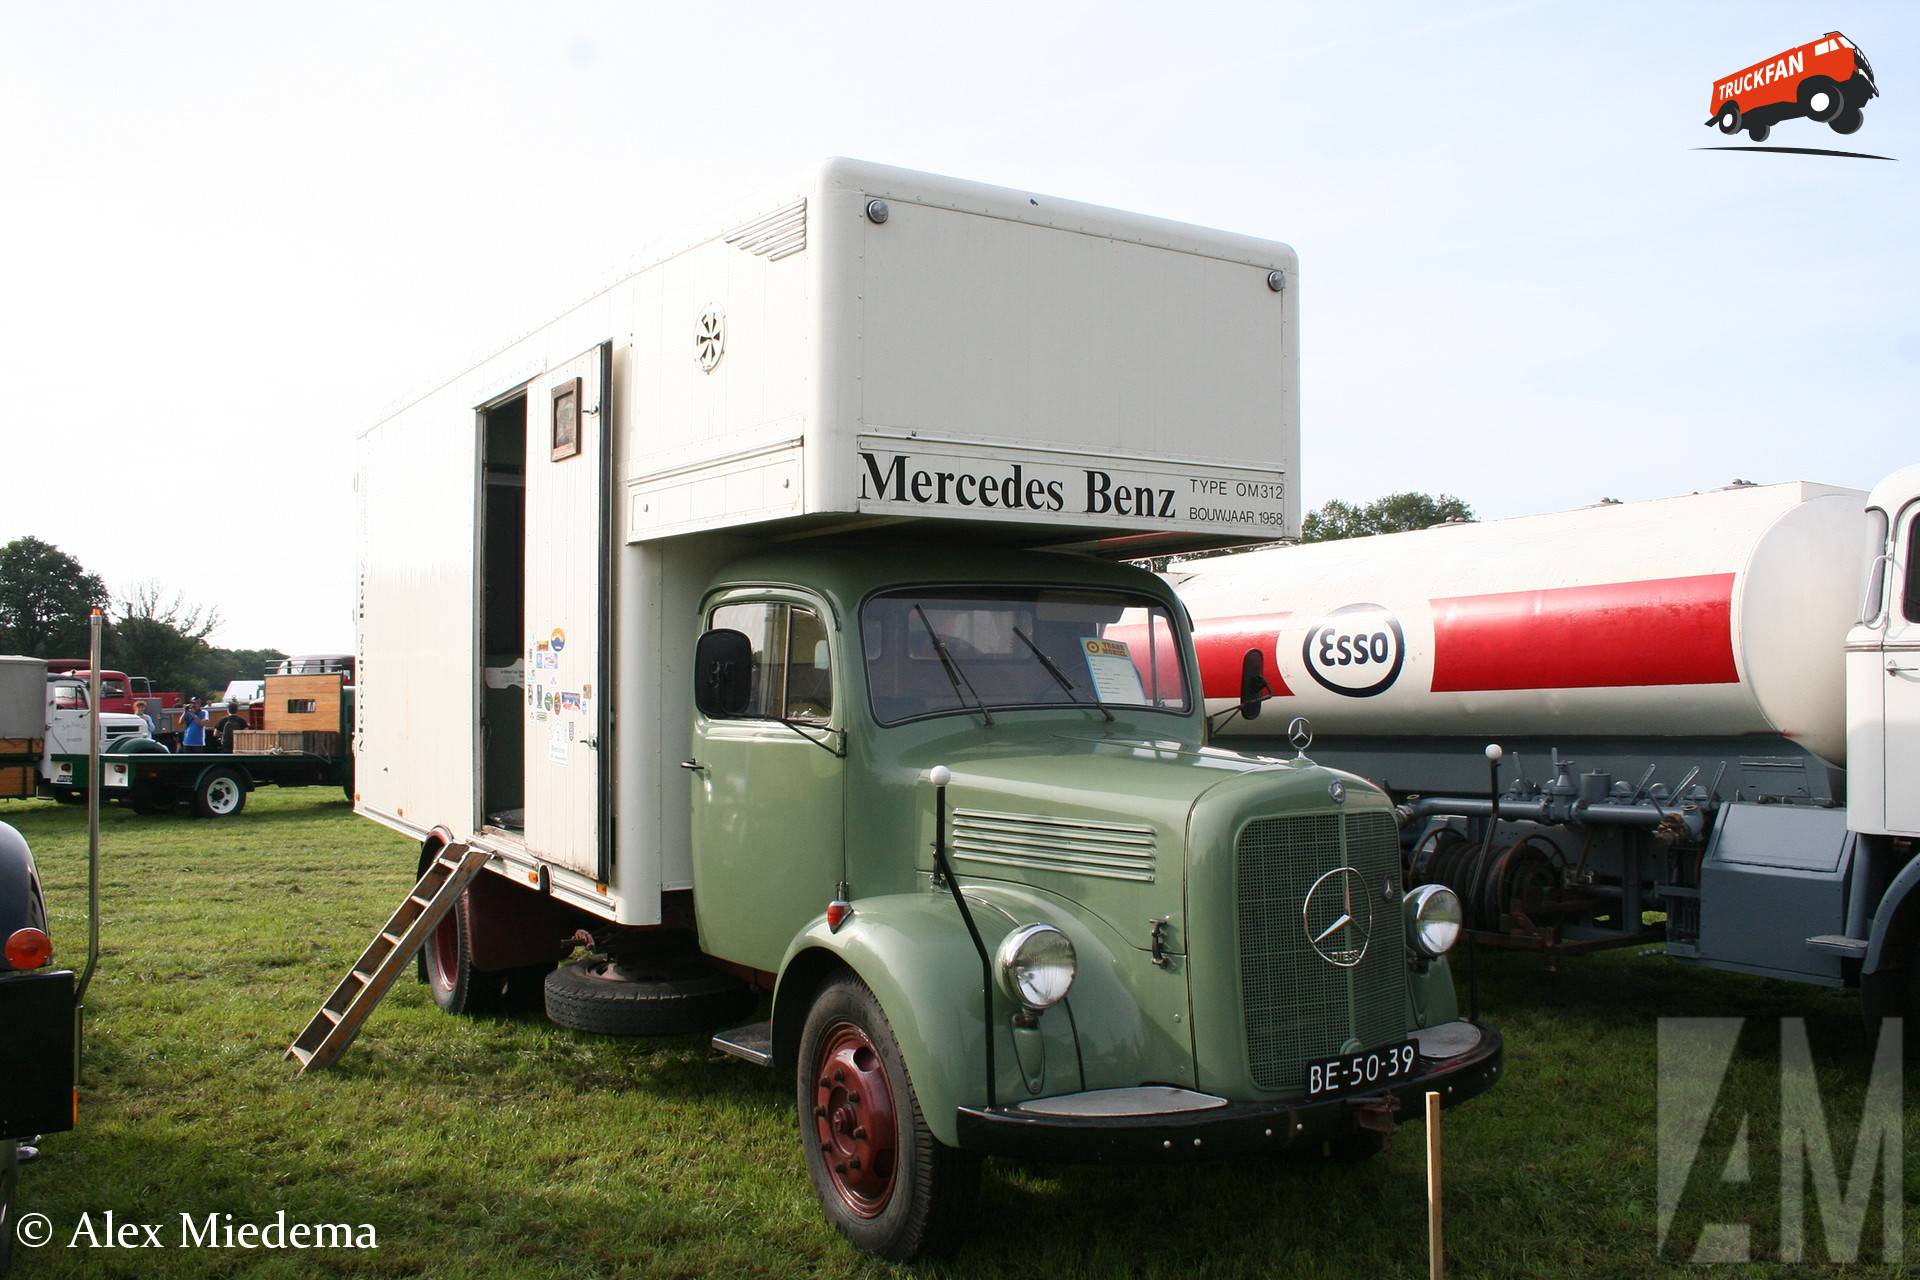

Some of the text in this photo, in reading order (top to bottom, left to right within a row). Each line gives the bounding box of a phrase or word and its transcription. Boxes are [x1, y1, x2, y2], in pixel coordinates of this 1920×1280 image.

[859, 452, 1176, 518] Mercedes Benz
[1190, 479, 1283, 499] TYPE OM312
[1189, 507, 1283, 525] BOUWJAAR 1958
[1310, 1045, 1414, 1094] BE-50-39
